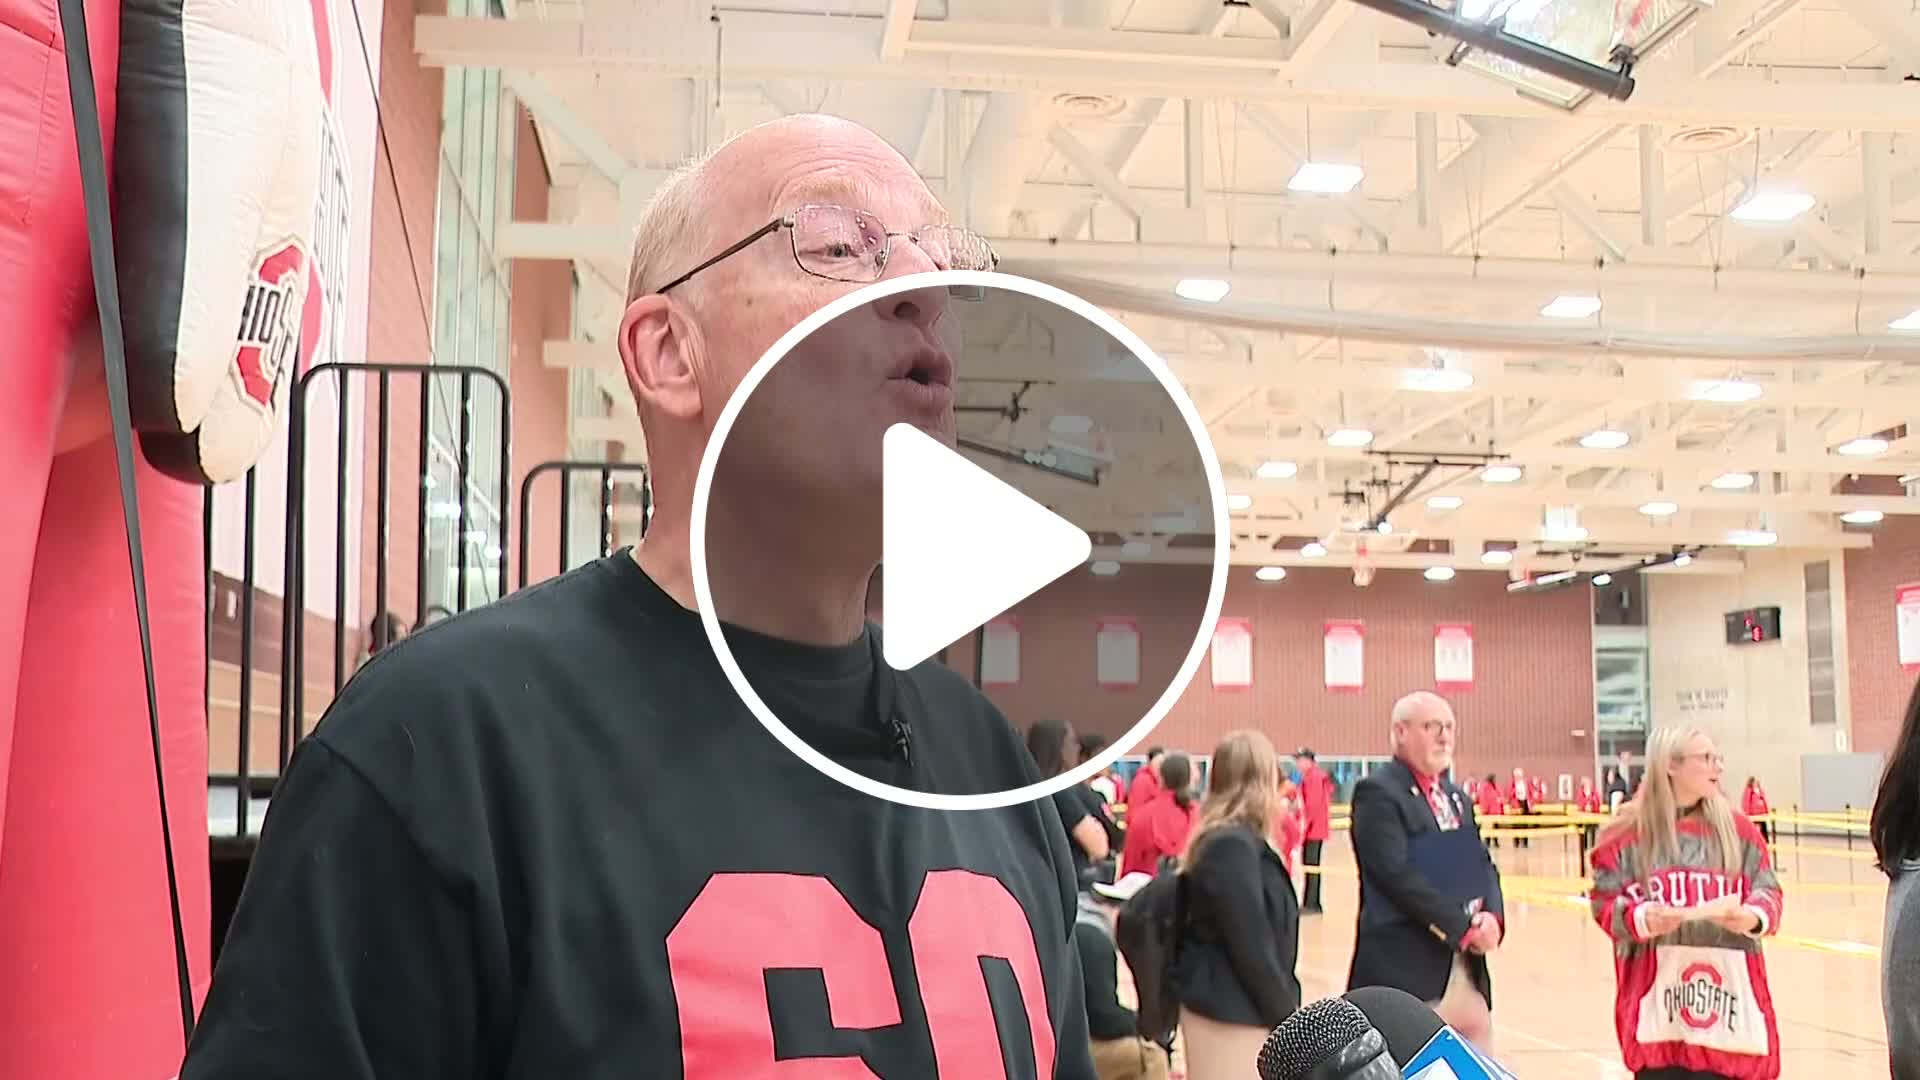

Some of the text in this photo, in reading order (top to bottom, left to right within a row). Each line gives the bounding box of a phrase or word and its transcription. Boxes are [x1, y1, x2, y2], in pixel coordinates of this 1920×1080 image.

[1626, 870, 1743, 907] BRUTU
[1664, 978, 1738, 1033] OHIO STATE
